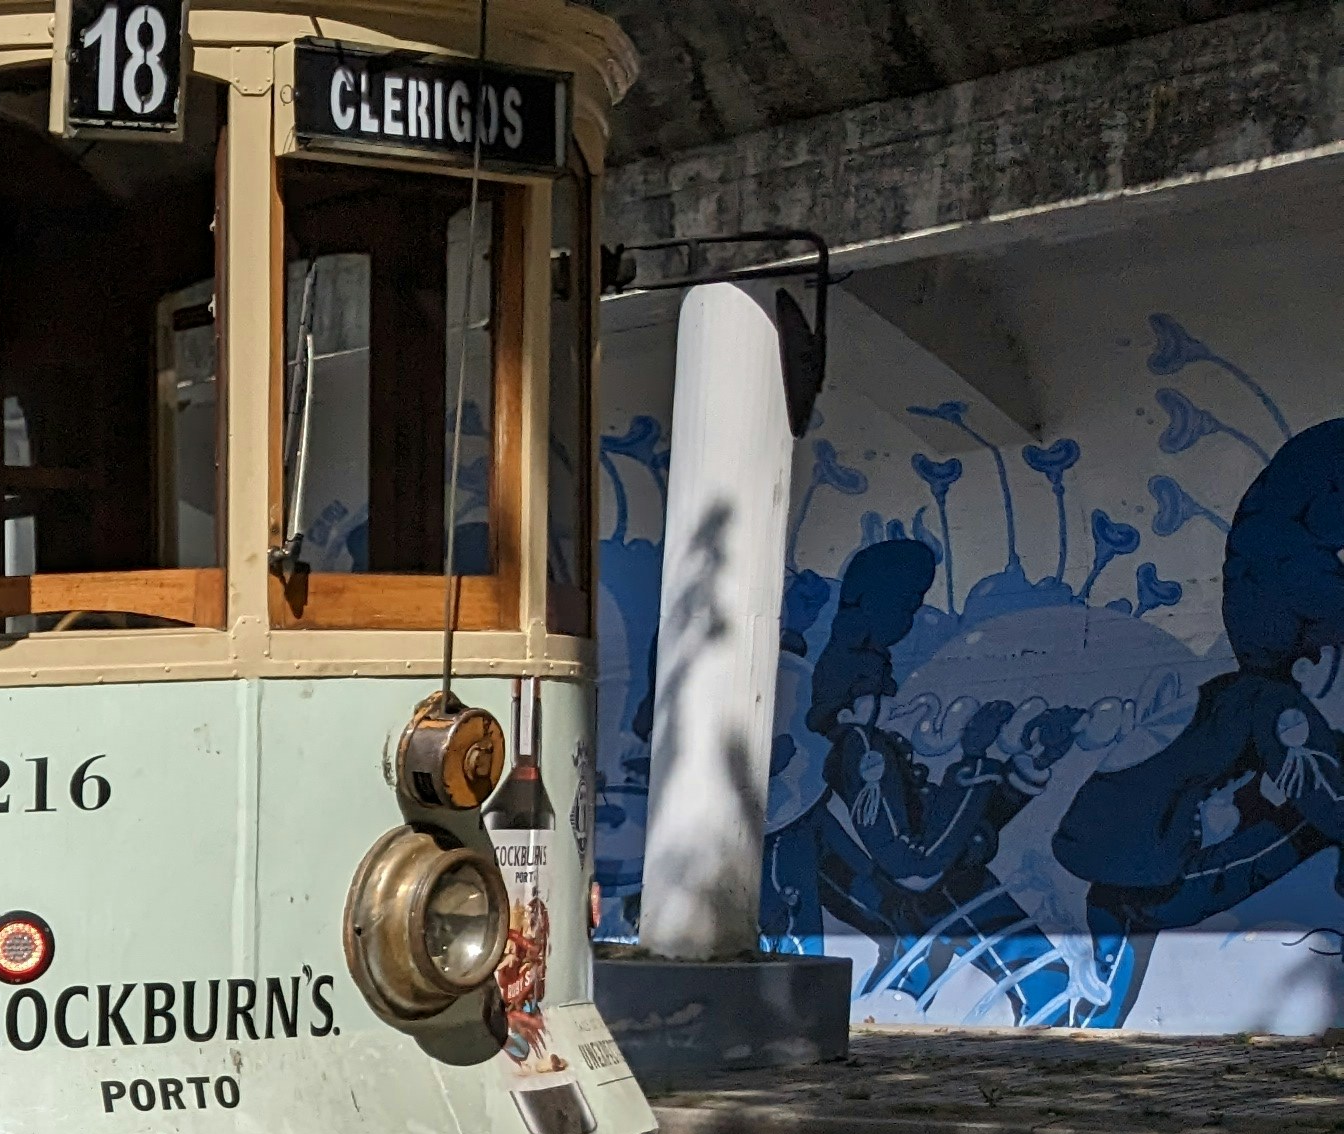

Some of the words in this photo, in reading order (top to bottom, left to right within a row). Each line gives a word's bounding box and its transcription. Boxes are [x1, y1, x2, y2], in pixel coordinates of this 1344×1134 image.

[83, 3, 168, 114] 18
[330, 66, 523, 149] CLERIGOS
[100, 1075, 241, 1113] PORTO
